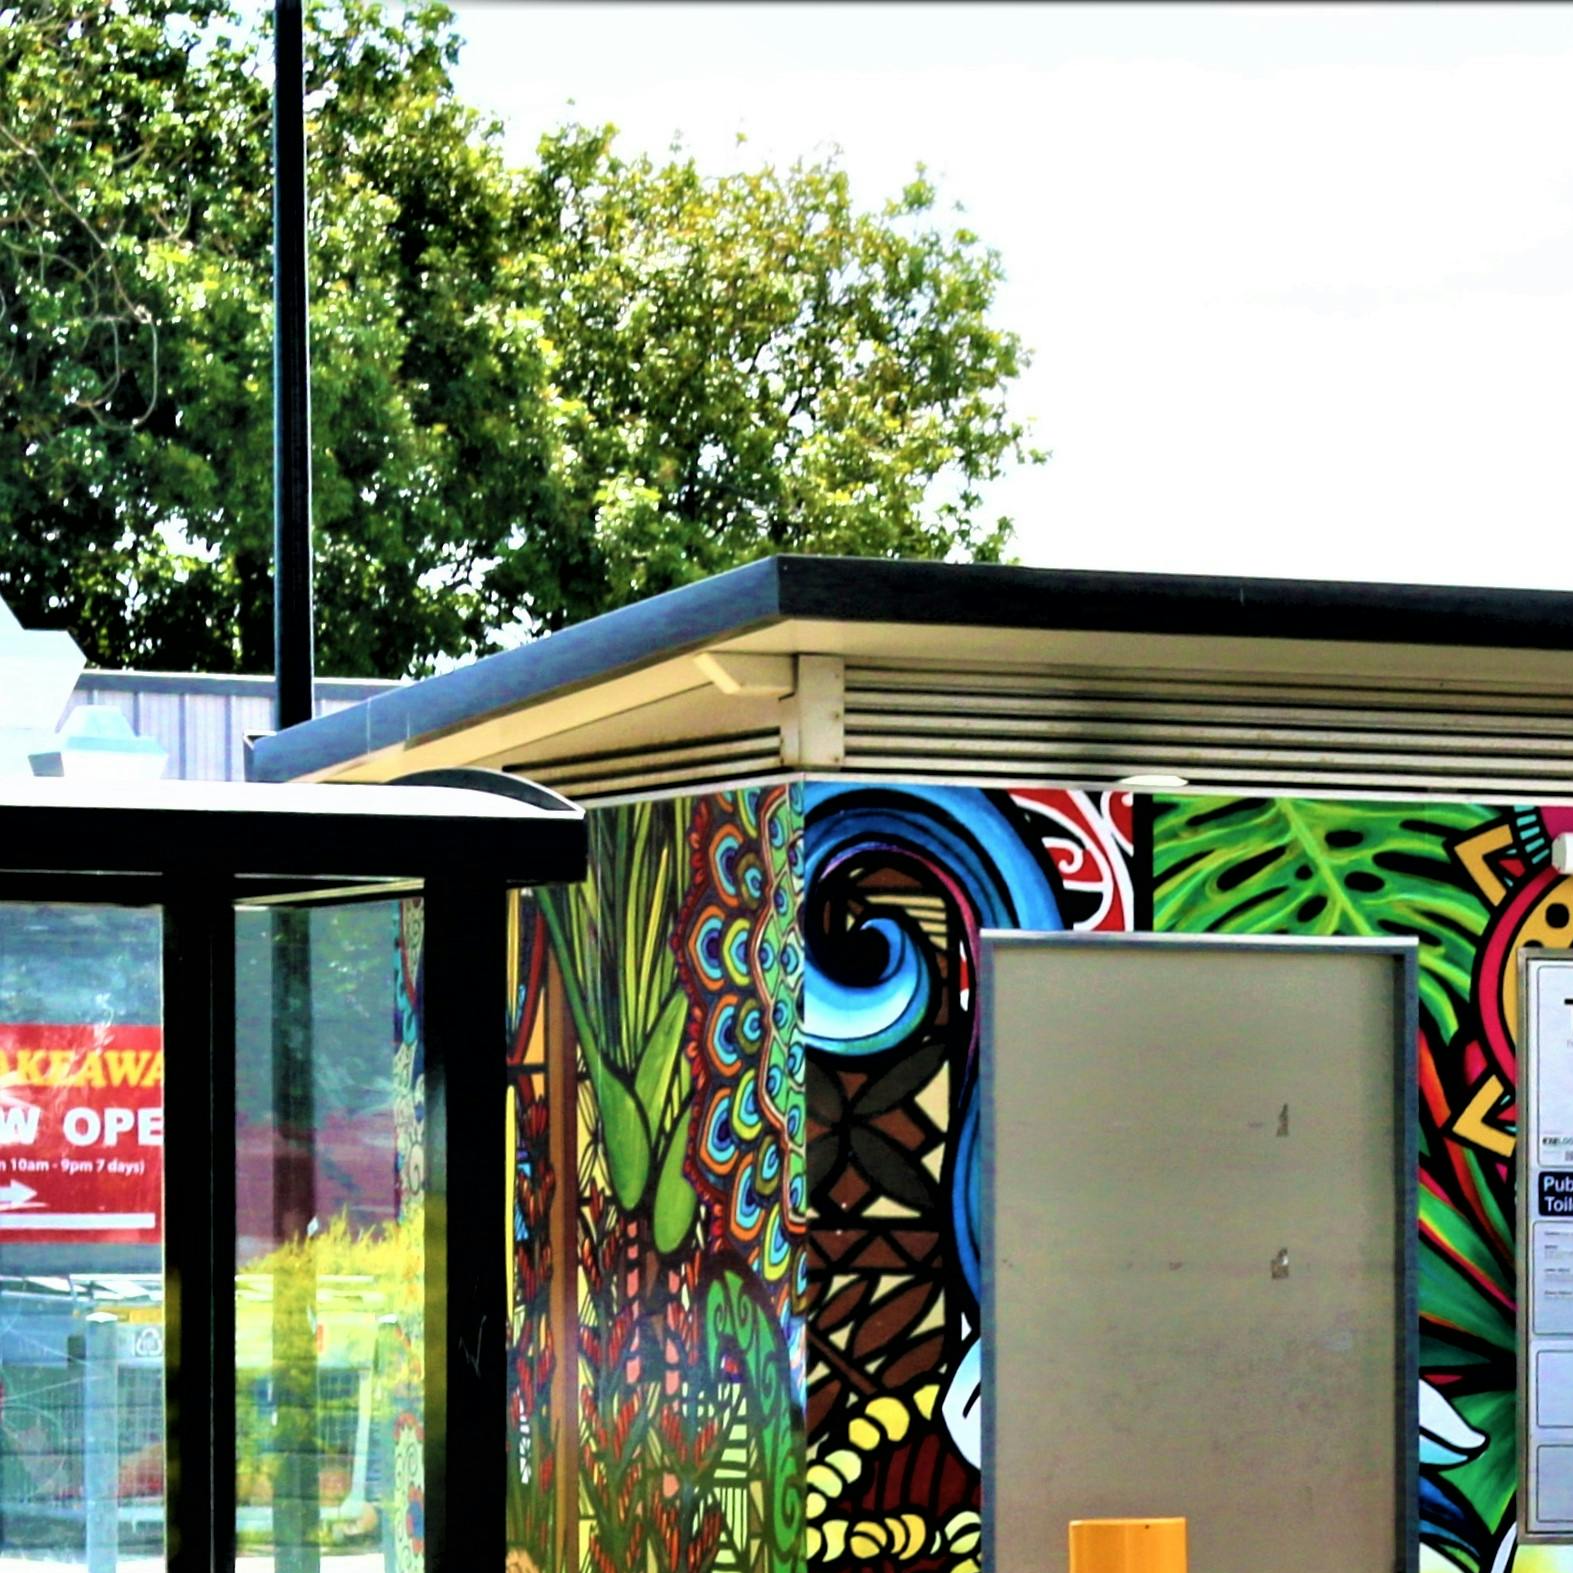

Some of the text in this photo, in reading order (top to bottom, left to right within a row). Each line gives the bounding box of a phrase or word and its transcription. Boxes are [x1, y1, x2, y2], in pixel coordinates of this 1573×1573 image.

[0, 1049, 163, 1088] KEAWA
[63, 1107, 163, 1146] OPE
[10, 1158, 49, 1172] 10am
[61, 1158, 93, 1175] 9pm
[96, 1159, 106, 1172] 7
[107, 1158, 145, 1177] days)
